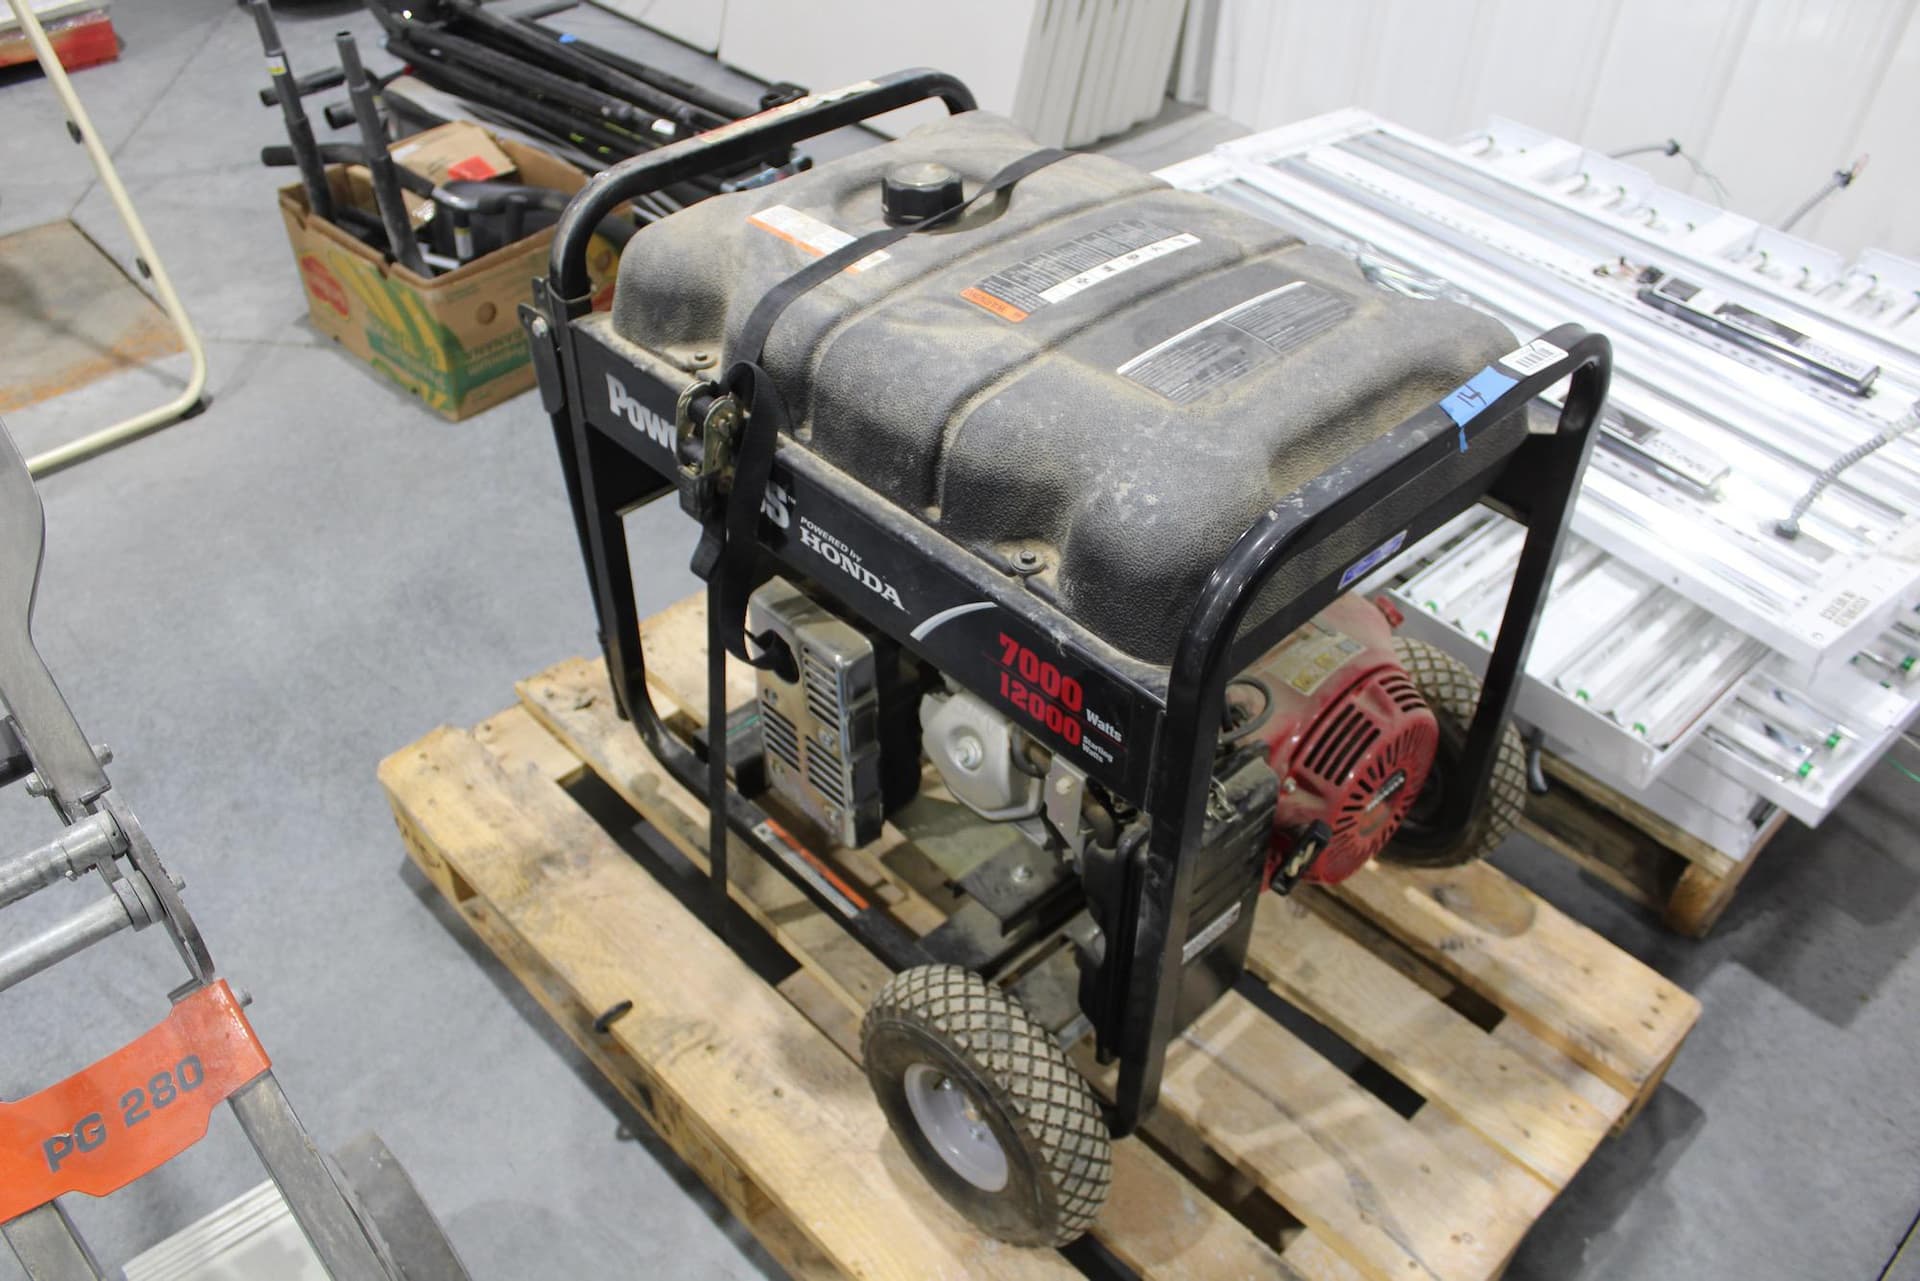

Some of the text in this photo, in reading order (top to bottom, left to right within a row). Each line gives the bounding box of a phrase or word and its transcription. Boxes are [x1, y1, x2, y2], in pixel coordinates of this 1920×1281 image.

[1456, 384, 1488, 408] 14
[800, 516, 849, 553] POWERED
[800, 526, 908, 613] HONDA
[999, 631, 1083, 713] 7000
[1000, 672, 1081, 746] 12000
[1086, 708, 1122, 742] Watts
[1082, 735, 1114, 763] Starting
[1082, 743, 1104, 763] Watts
[42, 1054, 205, 1173] PG 280
